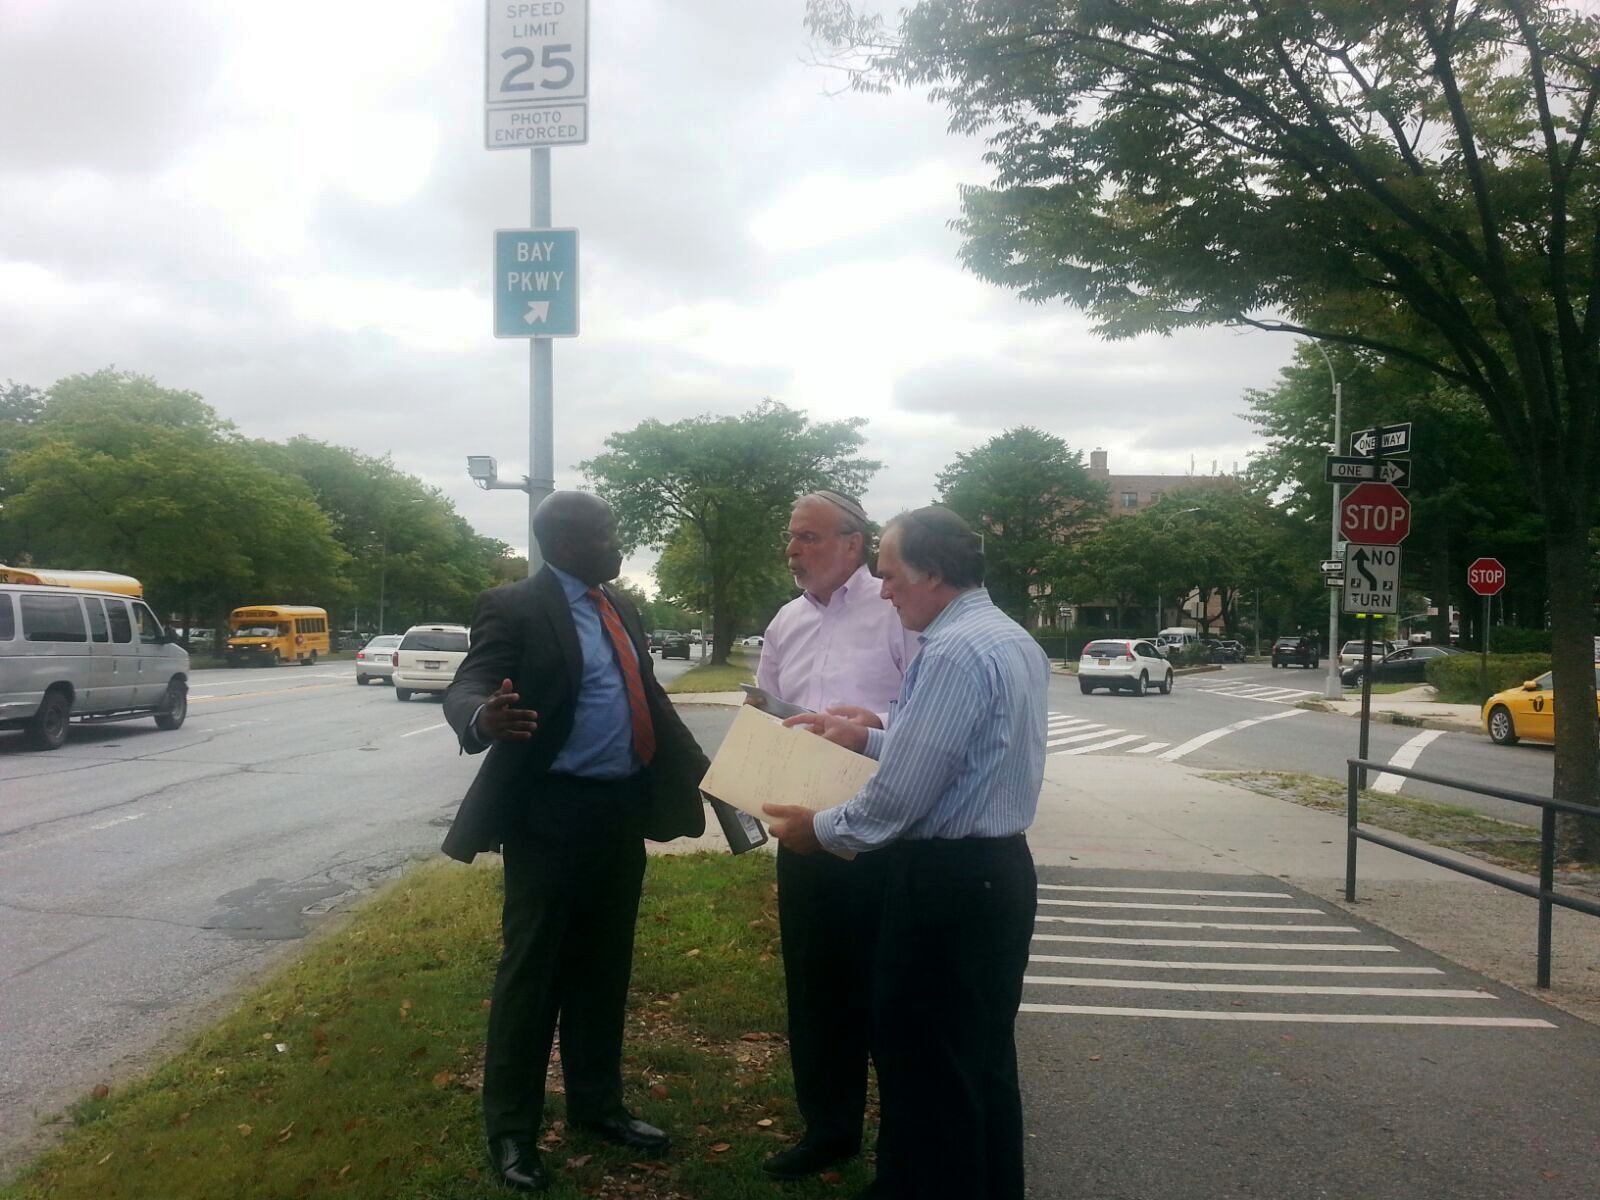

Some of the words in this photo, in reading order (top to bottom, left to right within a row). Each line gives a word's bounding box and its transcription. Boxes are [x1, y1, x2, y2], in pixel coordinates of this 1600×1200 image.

[506, 2, 565, 19] SPEED
[512, 22, 559, 38] LIMIT
[500, 44, 575, 92] 25
[511, 111, 562, 125] PHOTO
[495, 125, 578, 142] ENFORCED
[517, 242, 554, 262] BAY
[508, 271, 564, 292] PKWY
[1359, 438, 1376, 450] ONE
[1383, 433, 1402, 446] WAY
[1338, 464, 1362, 477] ONE
[1381, 467, 1398, 479] AY
[1345, 504, 1405, 531] STOP
[1371, 550, 1396, 566] NO
[1470, 569, 1503, 584] STOP
[1351, 593, 1392, 607] TURN
